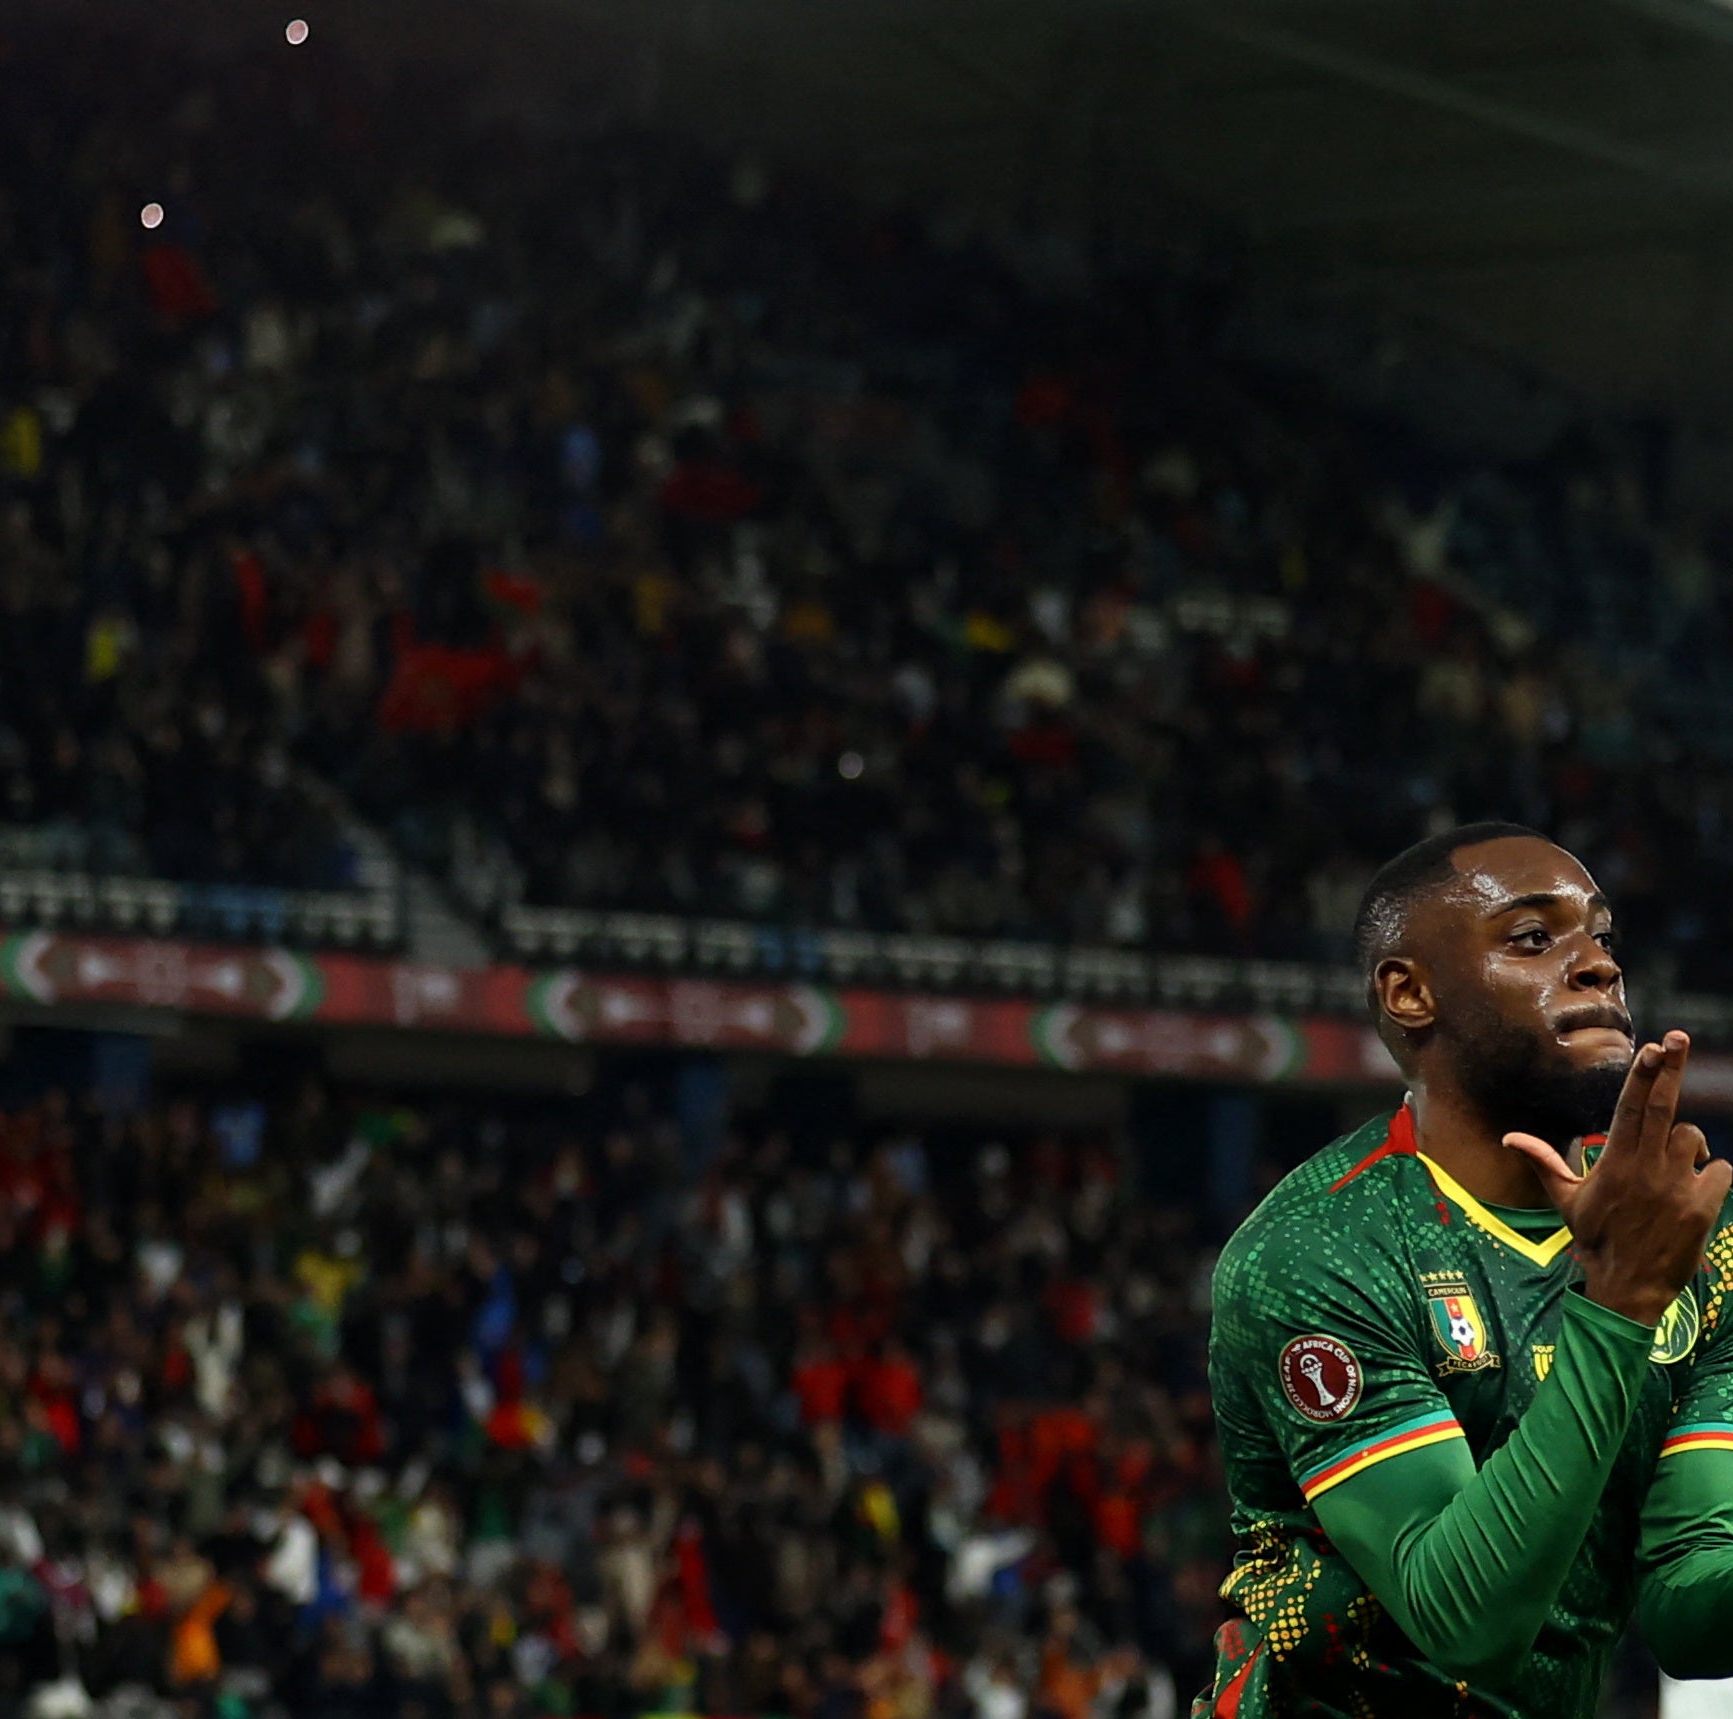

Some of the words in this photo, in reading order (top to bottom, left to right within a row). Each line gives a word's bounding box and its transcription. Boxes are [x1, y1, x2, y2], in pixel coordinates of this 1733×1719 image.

[1302, 1340, 1334, 1353] AFRICA
[1333, 1347, 1351, 1365] CUP
[1345, 1364, 1357, 1379] OF
[1332, 1379, 1358, 1414] NATIONS
